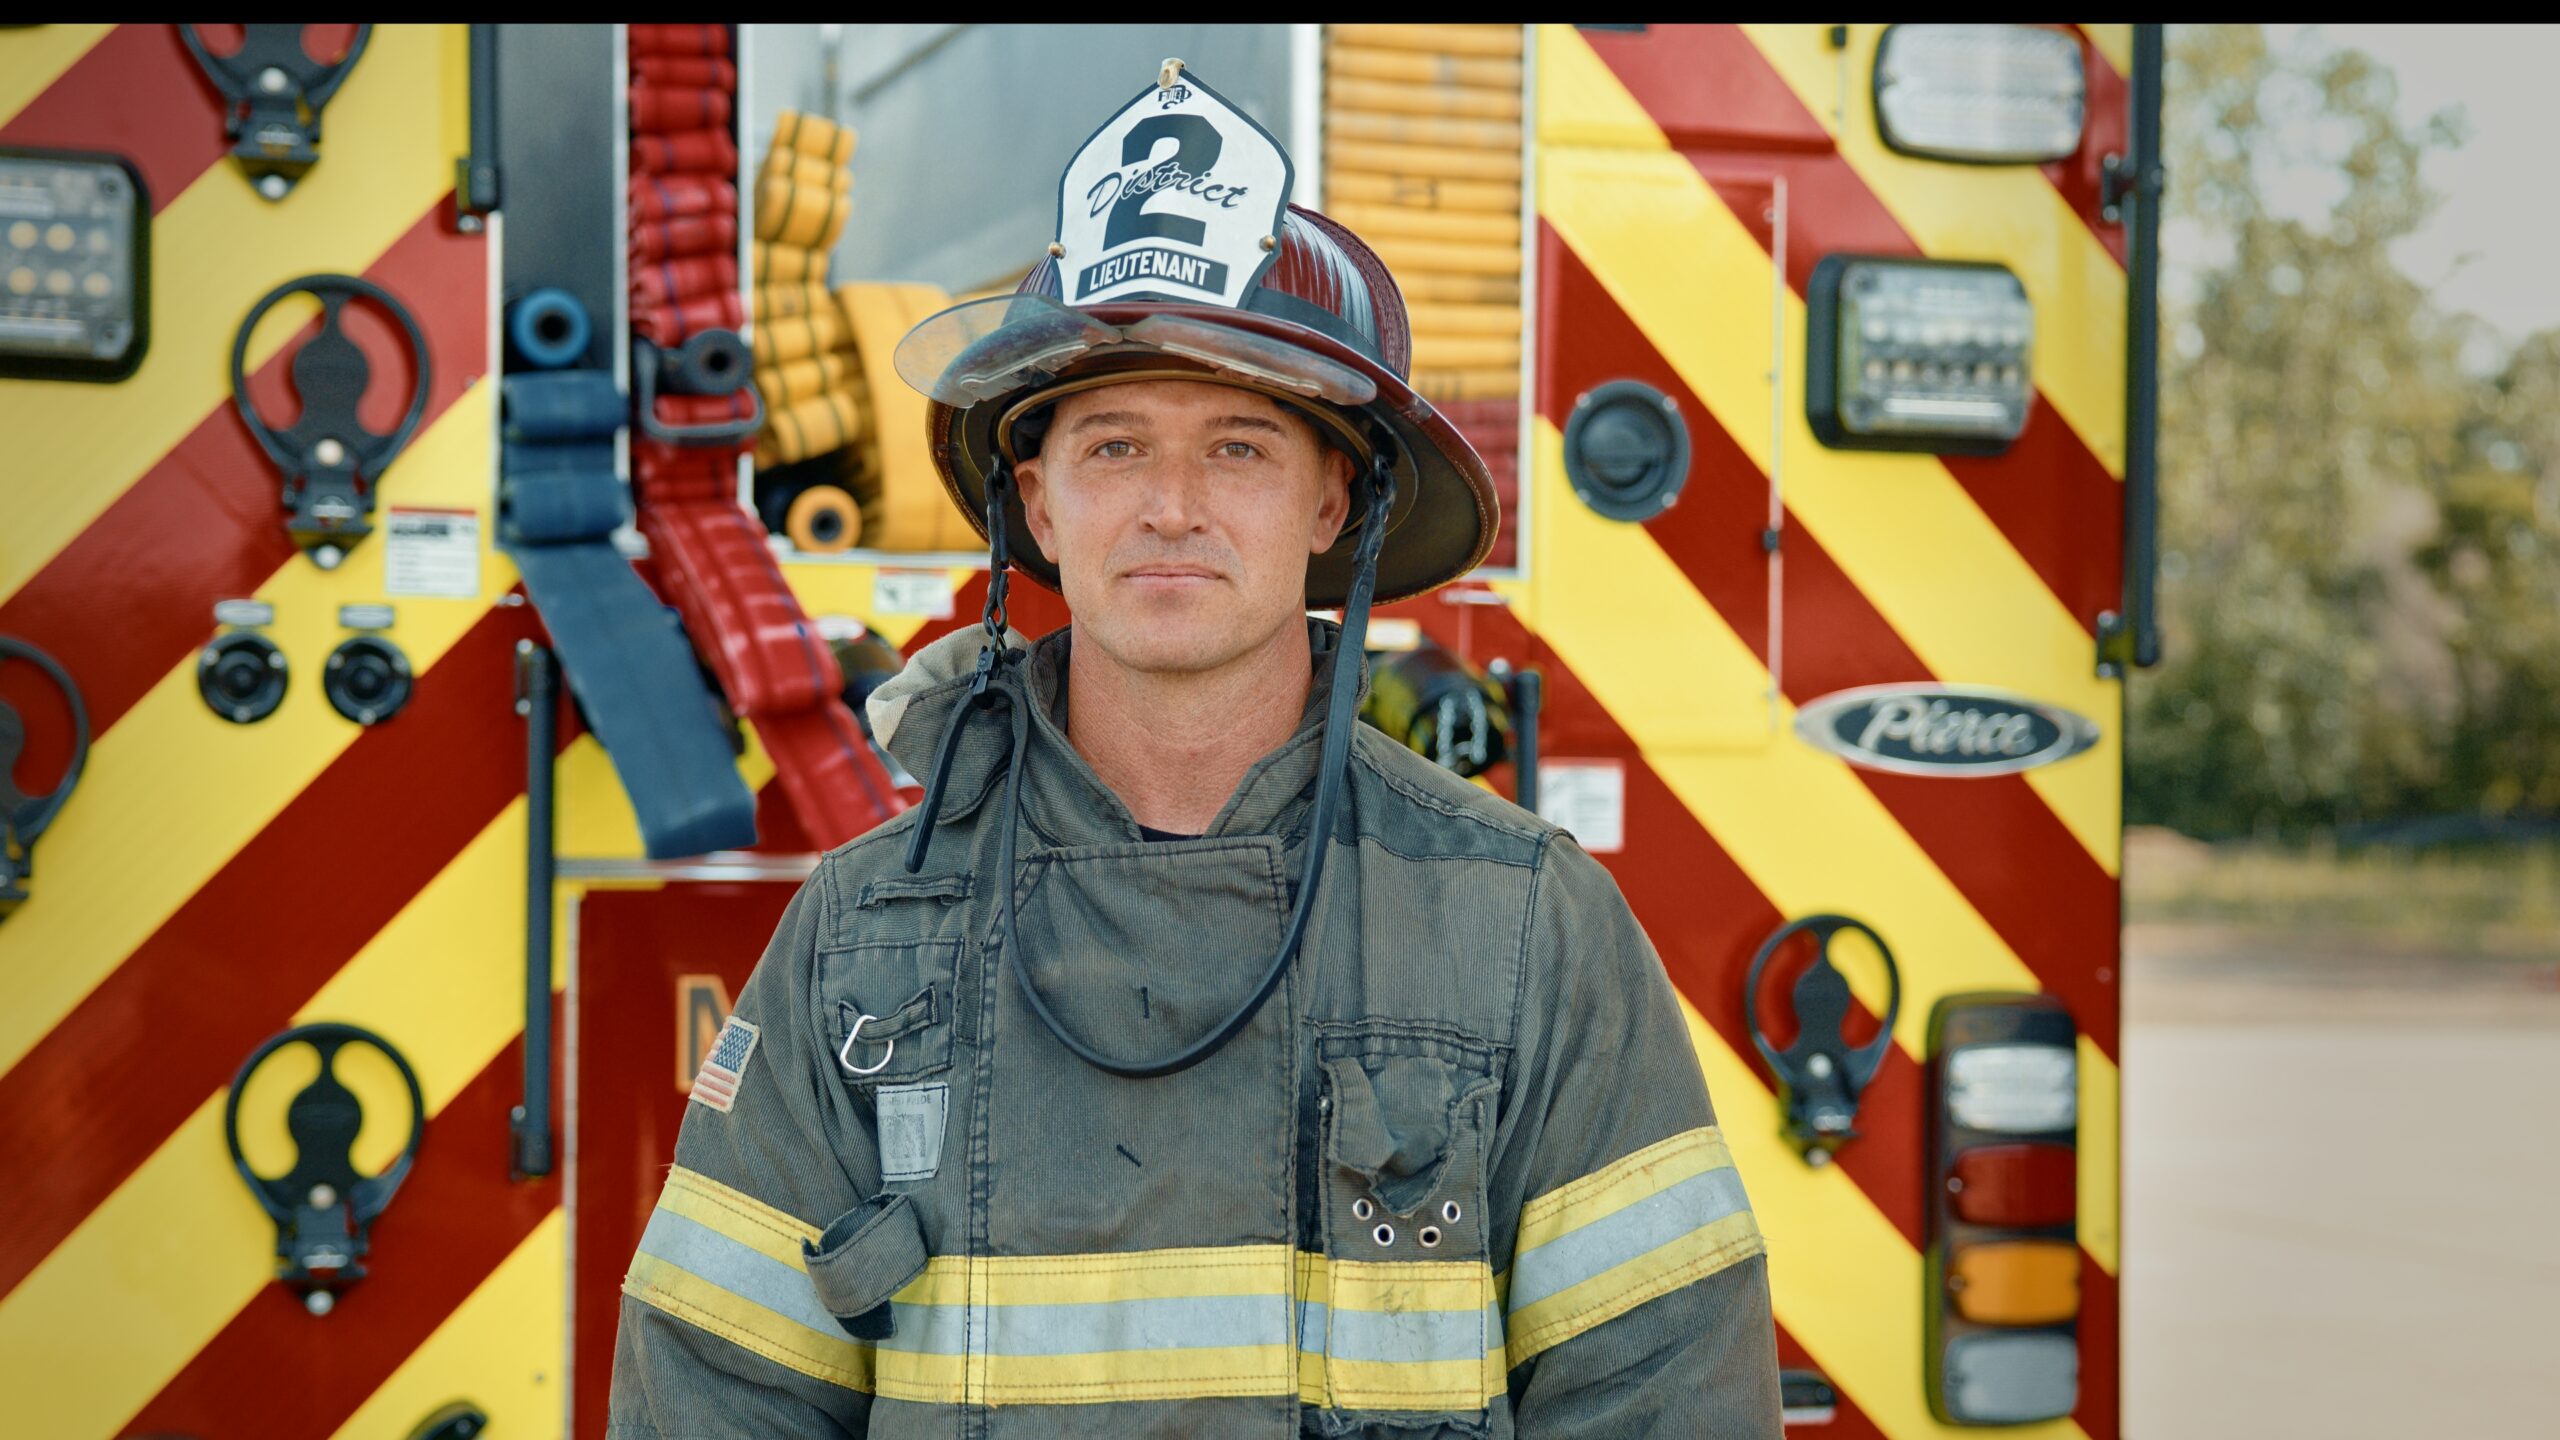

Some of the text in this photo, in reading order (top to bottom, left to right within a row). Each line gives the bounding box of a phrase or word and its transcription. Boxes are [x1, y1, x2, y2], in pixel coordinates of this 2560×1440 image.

[1087, 162, 1249, 219] District
[1103, 113, 1223, 252] 2
[1089, 250, 1211, 292] LIEUTENANT
[1858, 694, 2038, 756] Pierce
